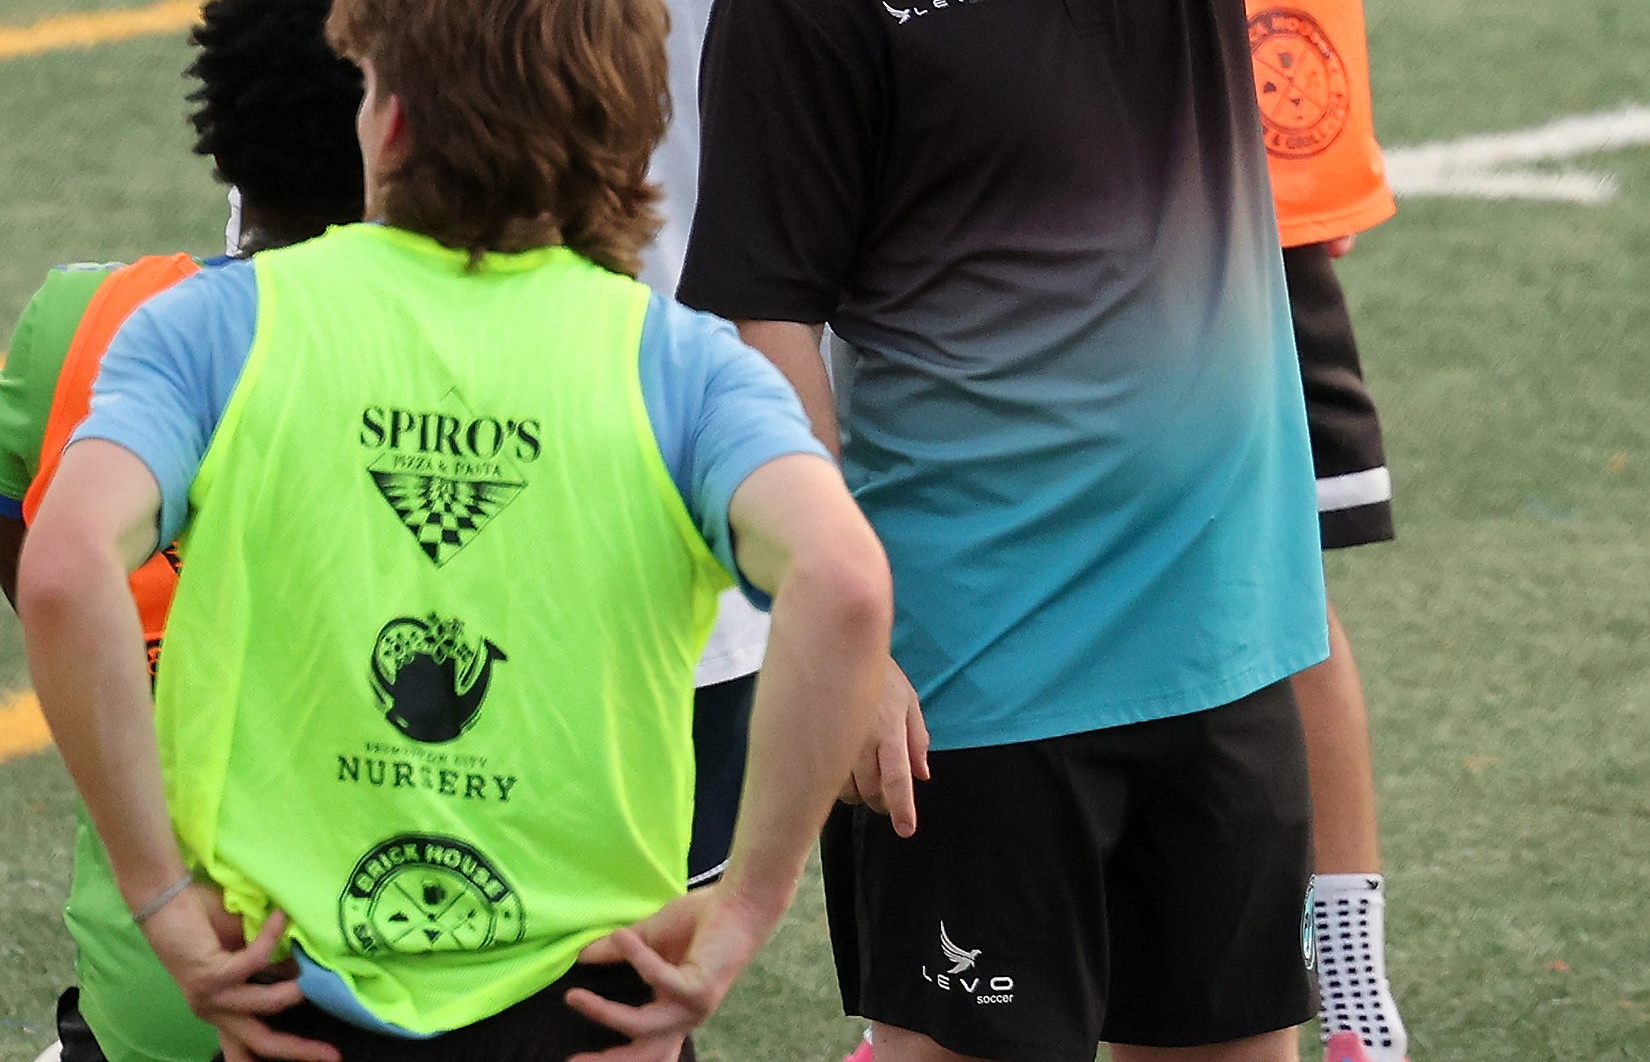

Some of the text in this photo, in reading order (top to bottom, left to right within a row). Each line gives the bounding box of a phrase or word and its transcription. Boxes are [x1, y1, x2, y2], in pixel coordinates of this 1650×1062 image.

[360, 405, 543, 464] SPIRO'S
[922, 965, 1014, 993] LEVO
[976, 994, 1014, 1005] soccer
